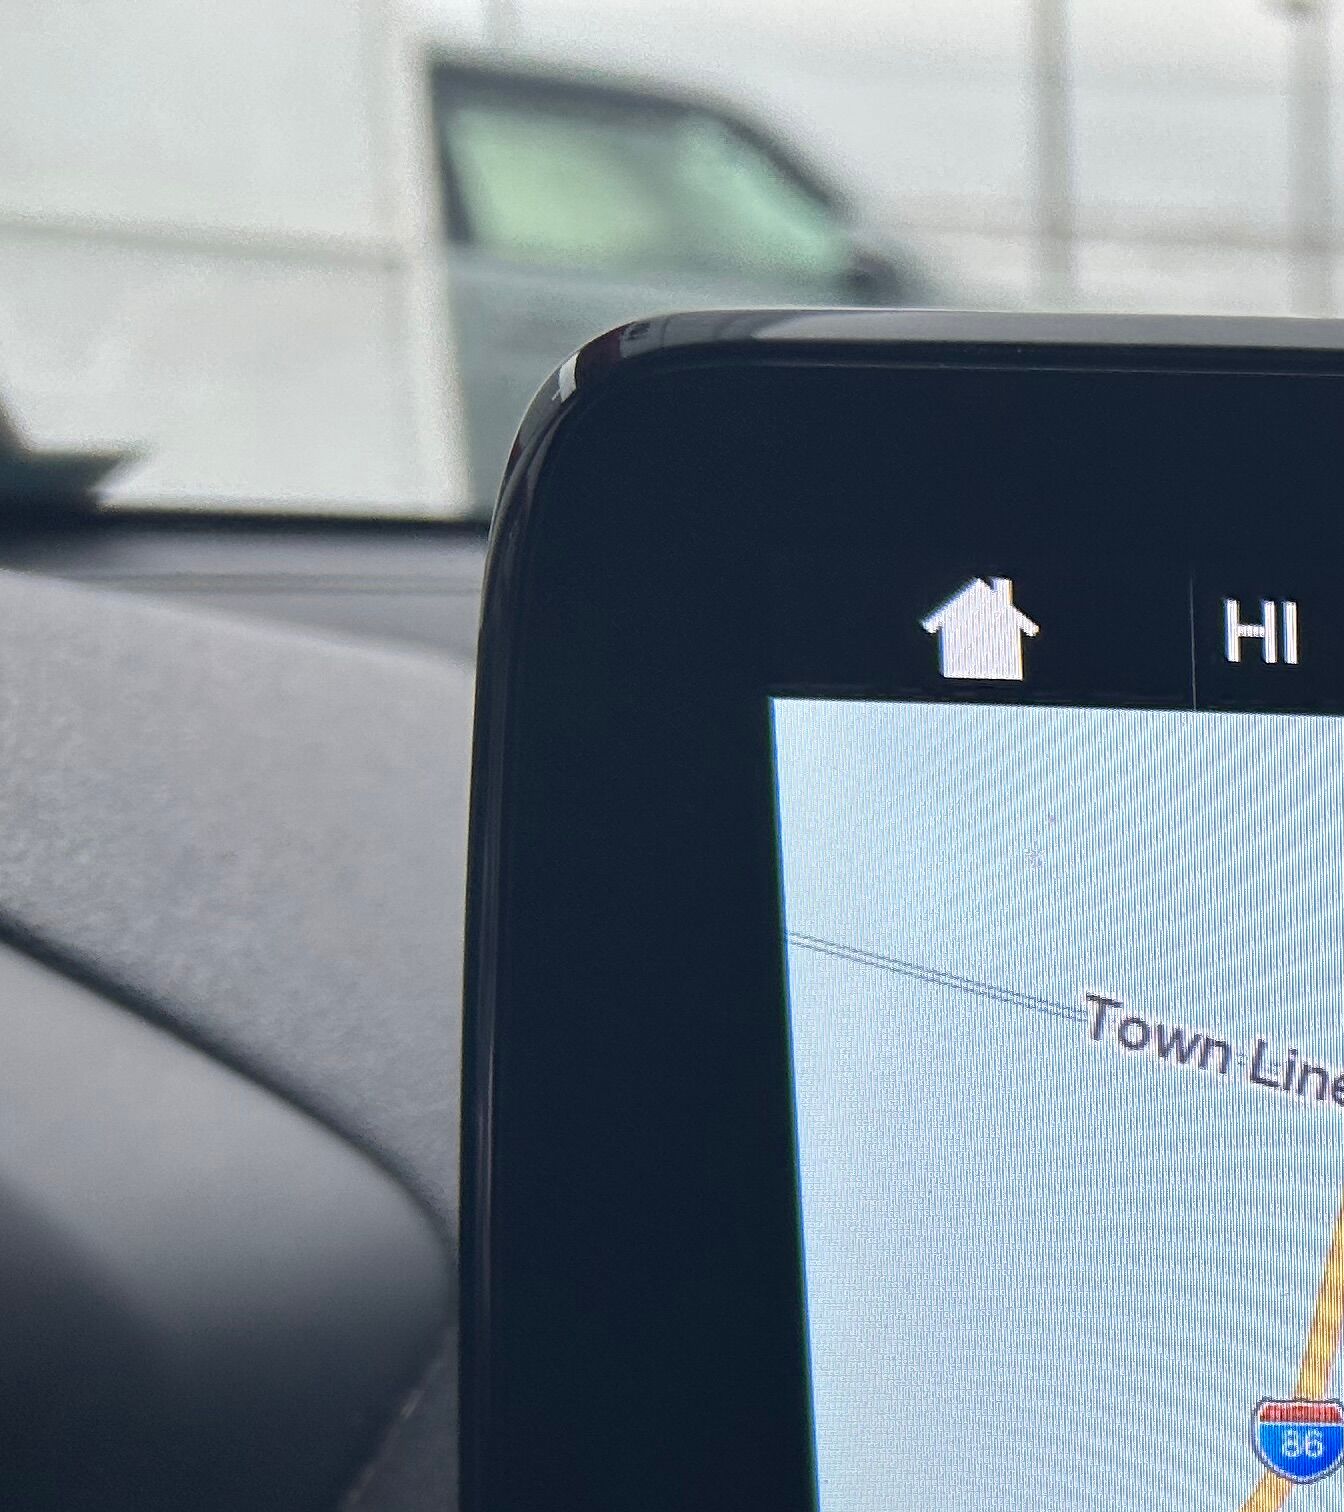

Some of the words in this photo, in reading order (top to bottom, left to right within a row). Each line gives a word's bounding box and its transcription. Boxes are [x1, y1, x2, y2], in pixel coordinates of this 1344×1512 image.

[1225, 600, 1298, 665] HI
[1085, 993, 1231, 1076] Town
[1281, 1428, 1324, 1459] 86
